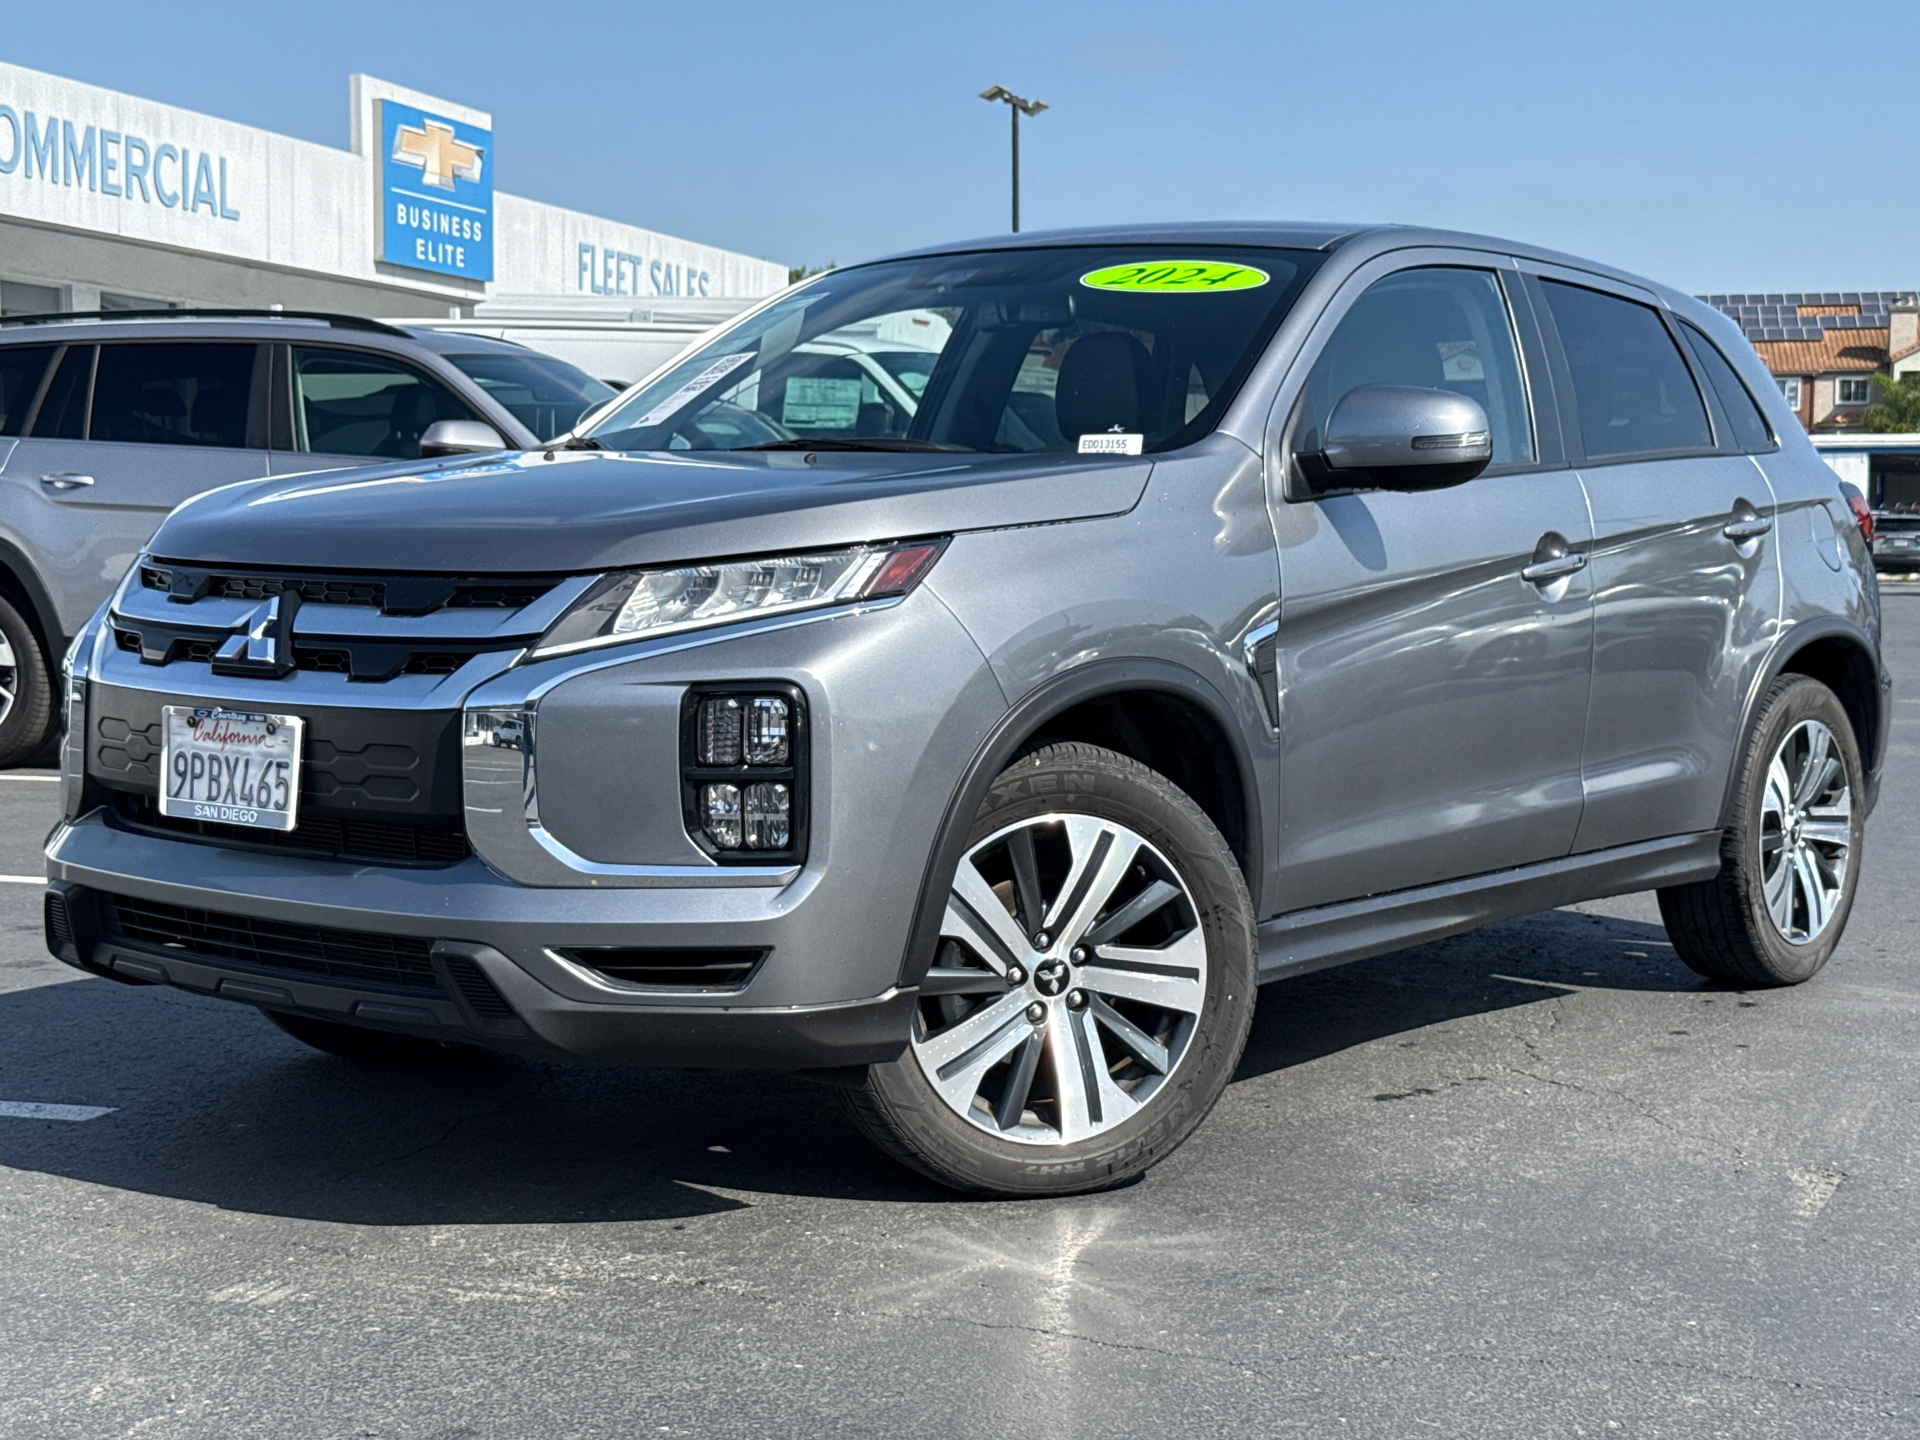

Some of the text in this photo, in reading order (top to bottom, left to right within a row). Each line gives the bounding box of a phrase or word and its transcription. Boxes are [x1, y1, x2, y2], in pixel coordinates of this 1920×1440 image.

[397, 202, 482, 242] BUSINESS
[416, 237, 465, 268] ELITE
[579, 241, 642, 296] FLEET
[1101, 267, 1245, 285] 2024
[211, 706, 247, 724] Courtesy
[193, 718, 275, 751] California
[172, 750, 290, 811] 9PBX465
[194, 804, 258, 823] SAN DIEGO
